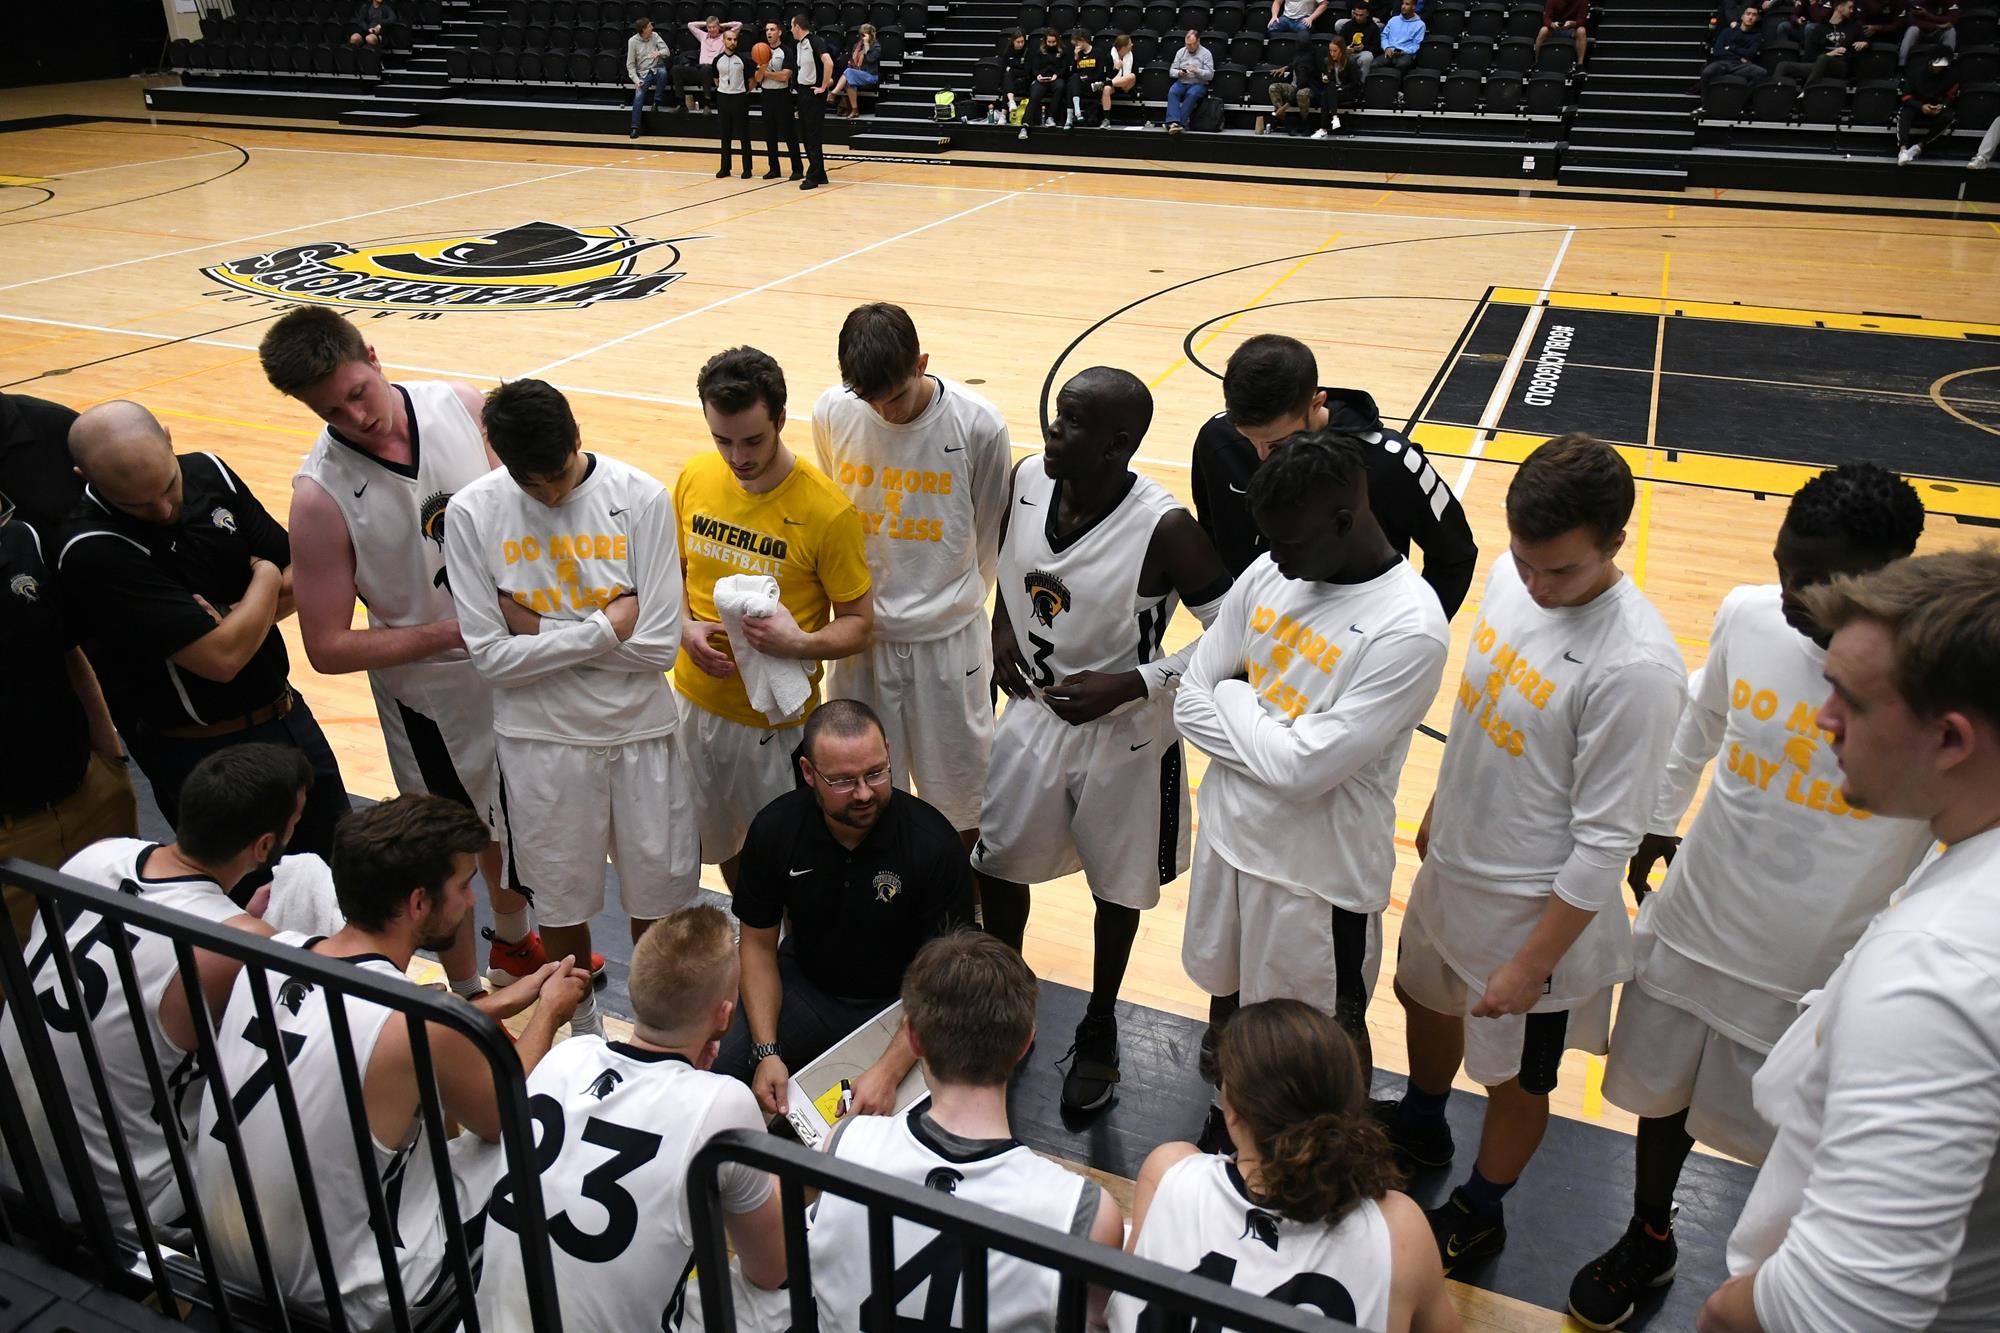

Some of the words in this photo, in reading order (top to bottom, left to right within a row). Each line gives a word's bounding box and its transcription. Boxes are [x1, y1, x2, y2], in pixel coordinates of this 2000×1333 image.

[221, 242, 688, 309] WARRIORS
[1523, 325, 1575, 406] #GOBLACKGOGOLD
[839, 463, 875, 488] DO
[881, 467, 953, 495] MORE
[503, 536, 541, 566] DO
[549, 533, 627, 560] MORE
[692, 513, 788, 560] WATERLOO
[860, 511, 885, 535] AY
[888, 516, 945, 542] LESS
[686, 533, 784, 577] BASKETBALL
[1028, 630, 1055, 689] 3
[1271, 614, 1342, 674] MORE
[1490, 642, 1556, 710] MORE
[1731, 678, 1779, 721] DO
[1727, 741, 1780, 791] SAY
